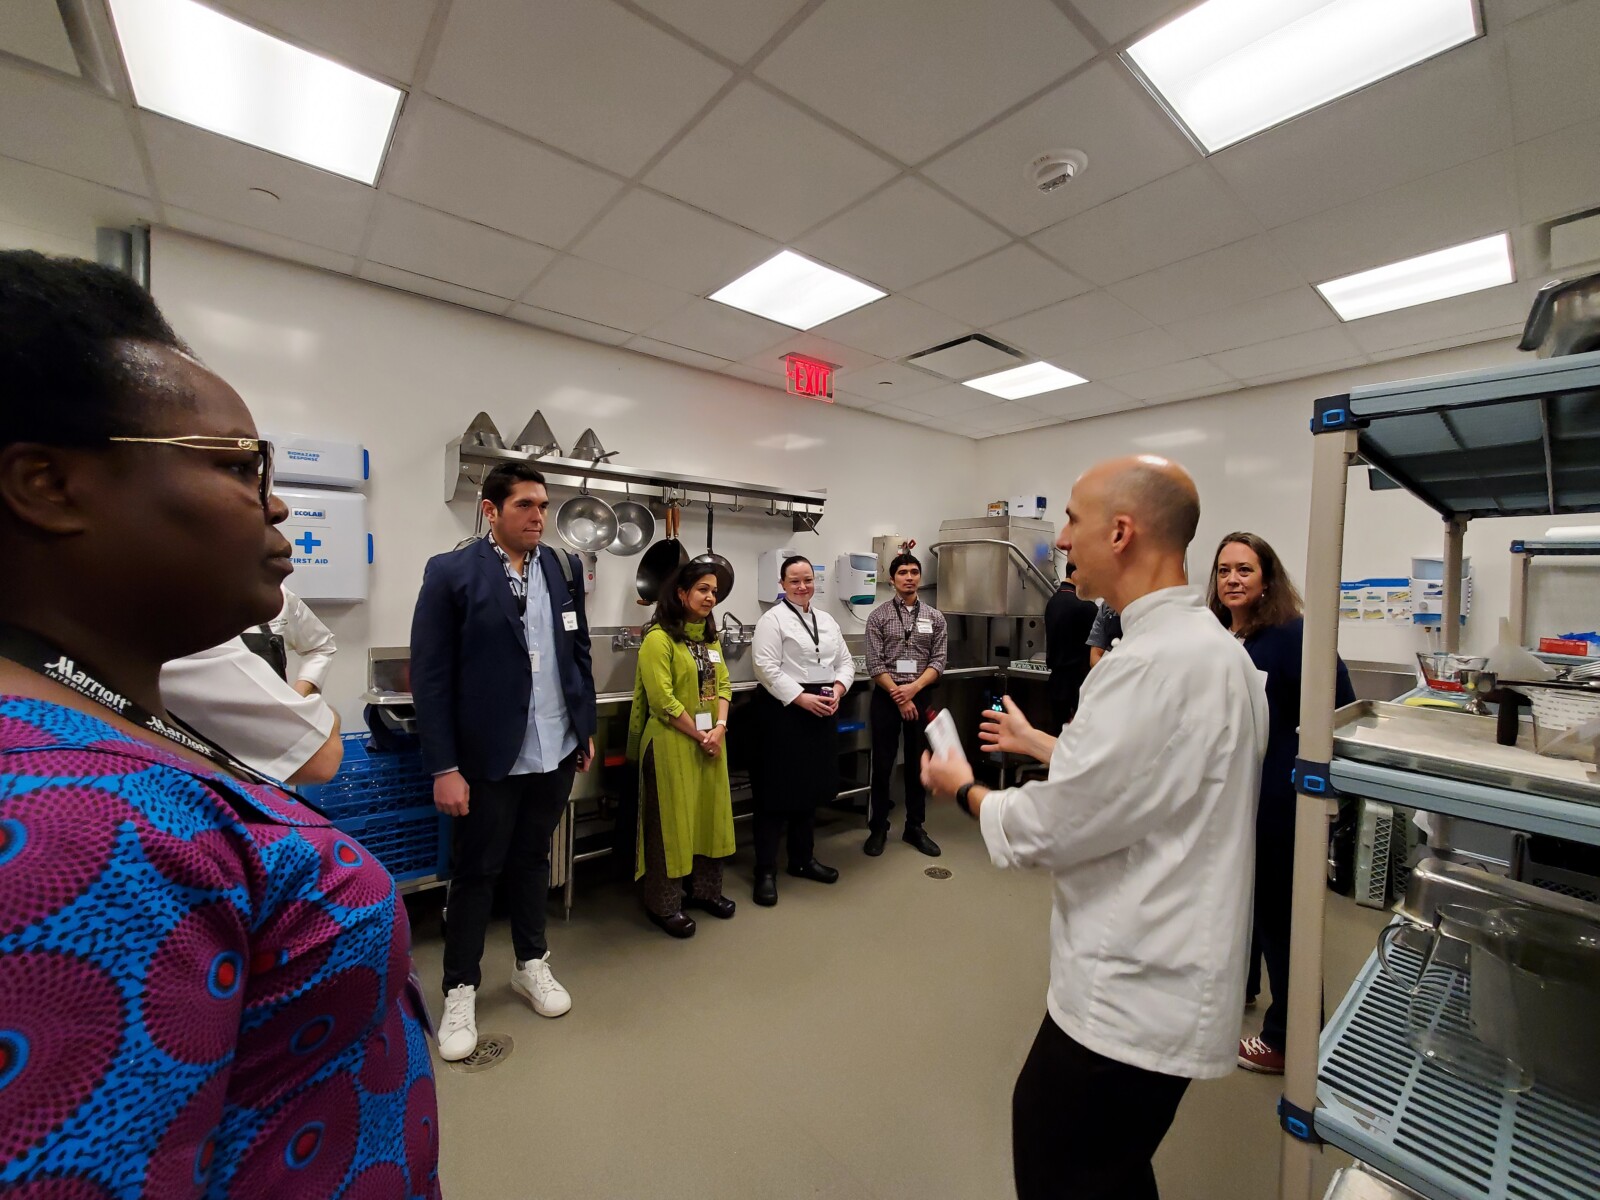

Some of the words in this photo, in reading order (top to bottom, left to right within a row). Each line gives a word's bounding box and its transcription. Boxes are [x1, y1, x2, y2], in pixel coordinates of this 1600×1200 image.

[795, 361, 830, 398] EXIT
[287, 450, 320, 458] BIOHAZARD
[294, 510, 323, 518] ECOLAB
[43, 656, 128, 710] Marriott
[44, 669, 123, 715] INTERNATIONAL
[145, 715, 212, 755] Marriott
